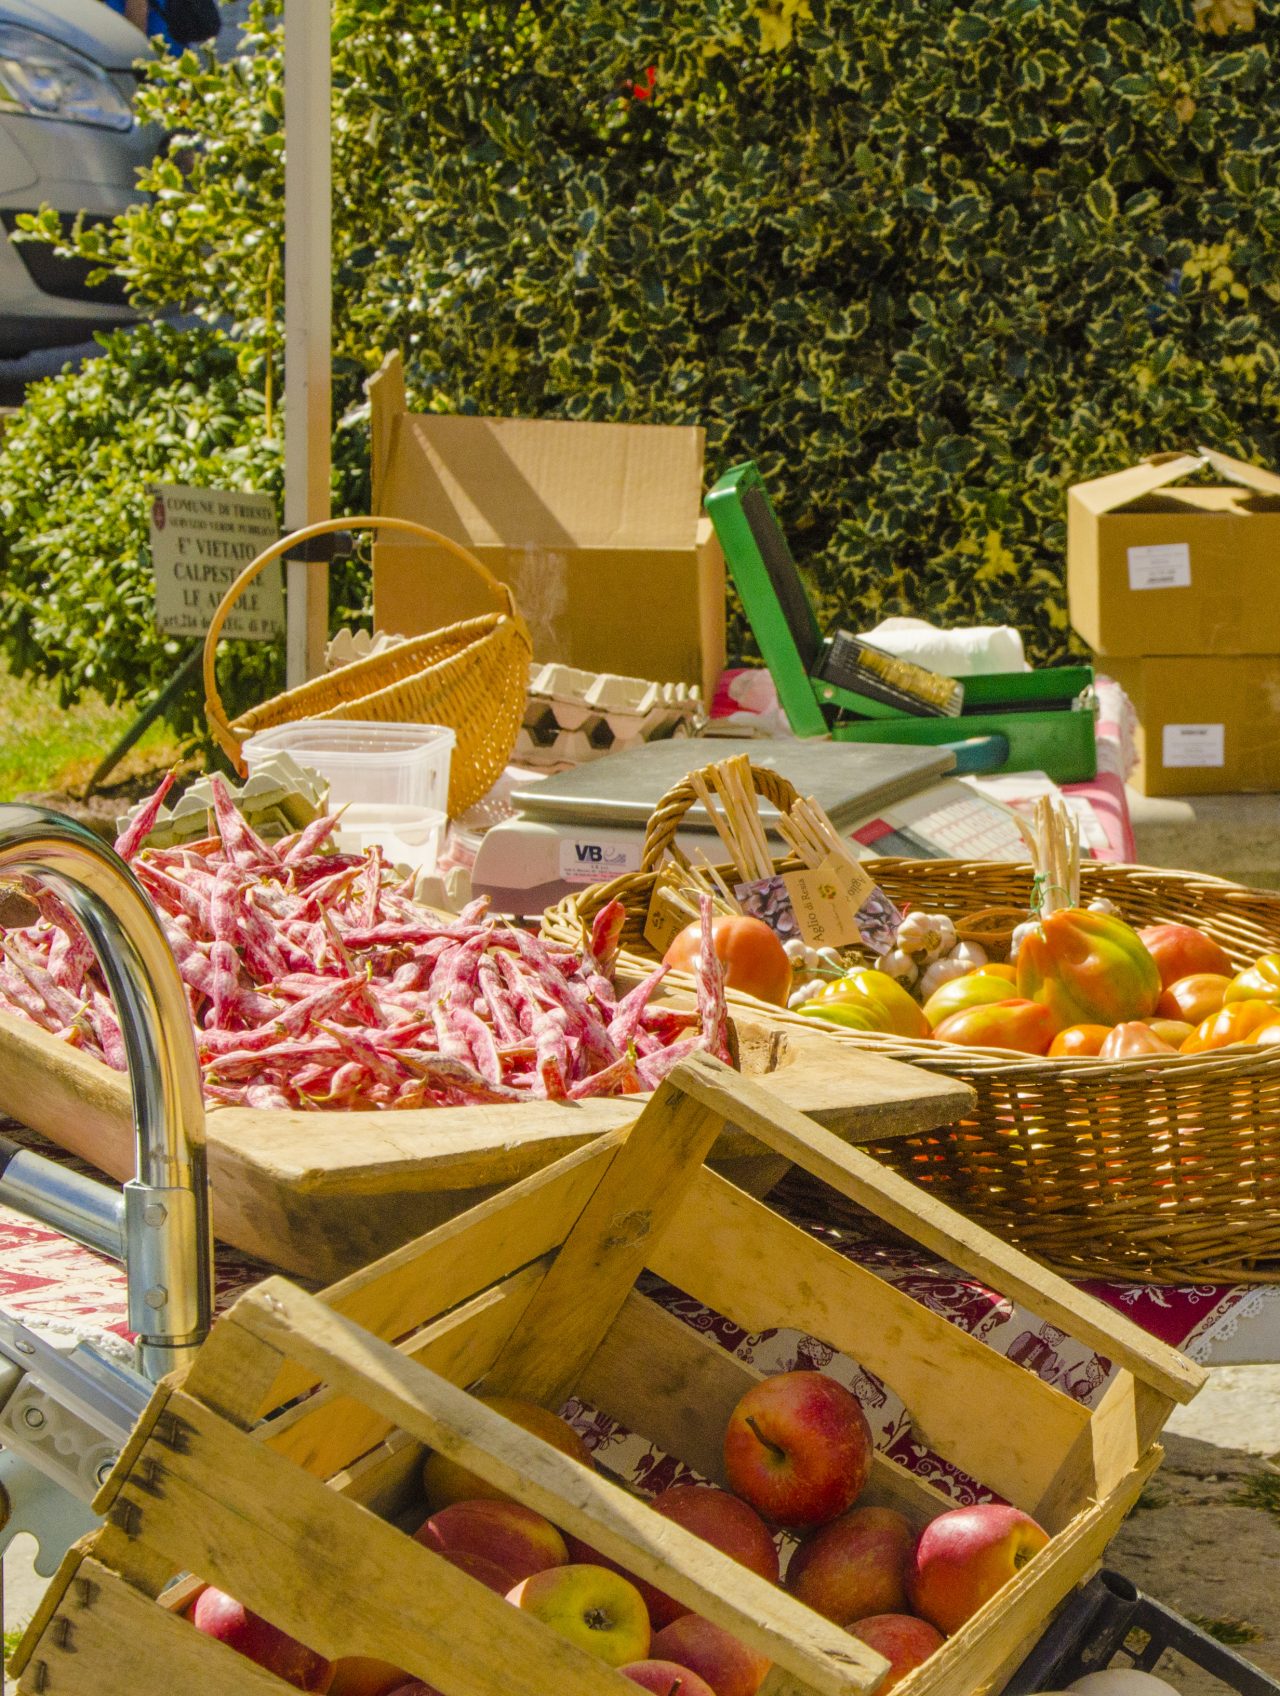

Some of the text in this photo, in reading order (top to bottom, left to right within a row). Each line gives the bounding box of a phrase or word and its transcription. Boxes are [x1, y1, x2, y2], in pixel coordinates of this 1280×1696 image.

[167, 497, 214, 514] COMUNE
[196, 538, 256, 560] VIETATO
[174, 561, 263, 587] CALPESTE
[183, 589, 200, 607] LE
[575, 844, 603, 862] VB
[848, 877, 868, 897] Aglio
[798, 878, 825, 942] Aglio di Resia
